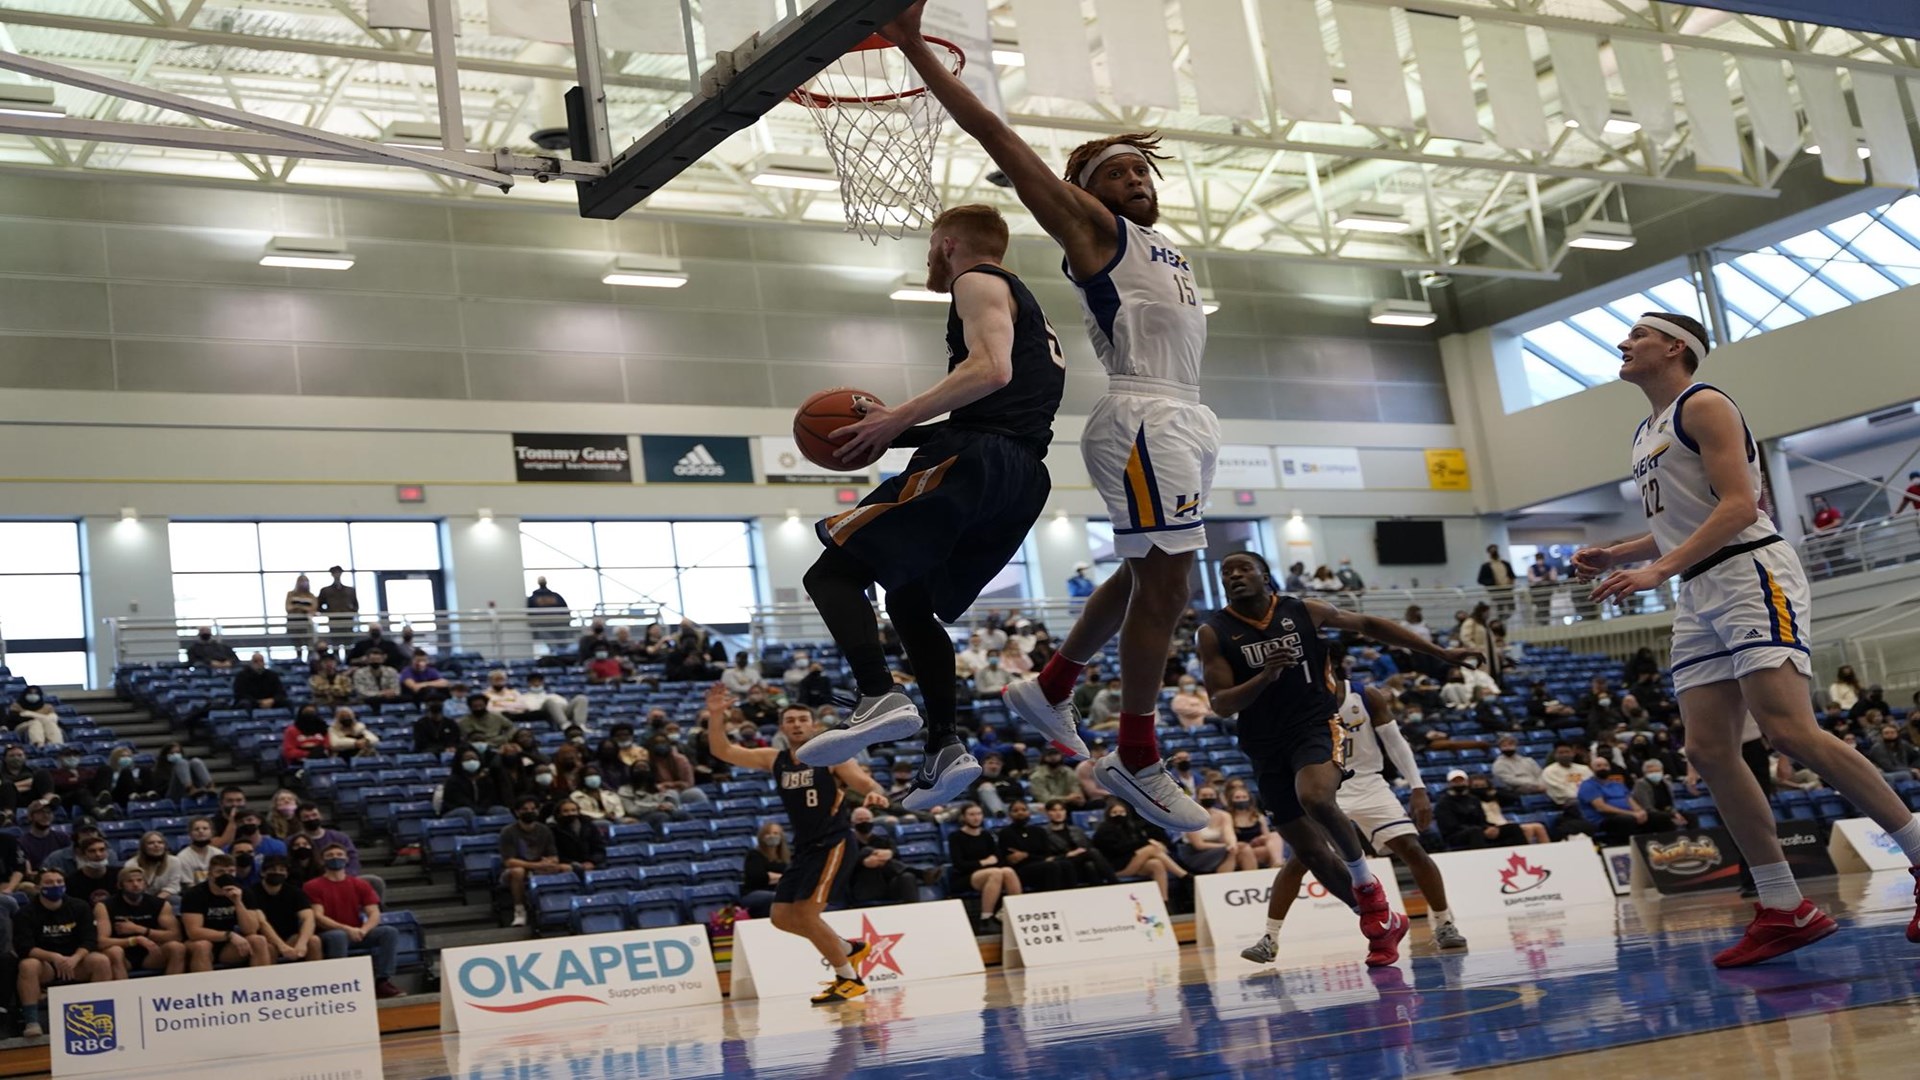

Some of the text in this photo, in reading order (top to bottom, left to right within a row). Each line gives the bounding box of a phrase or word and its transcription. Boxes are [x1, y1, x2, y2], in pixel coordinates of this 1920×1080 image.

[1173, 273, 1196, 307] 15
[515, 446, 580, 463] Tommy
[673, 464, 726, 476] adidas
[1642, 479, 1664, 518] 22
[1301, 660, 1312, 684] 1
[806, 789, 818, 808] 8
[1017, 911, 1057, 923] SPORT
[1020, 923, 1061, 934] YOUR
[1024, 934, 1064, 946] LOOK
[458, 939, 694, 998] OKAPED
[868, 972, 897, 982] RADIO
[152, 978, 362, 1012] Wealth Management
[608, 980, 702, 998] Supporting You
[155, 1000, 357, 1032] Dominion Securities
[70, 1037, 113, 1053] RBC
